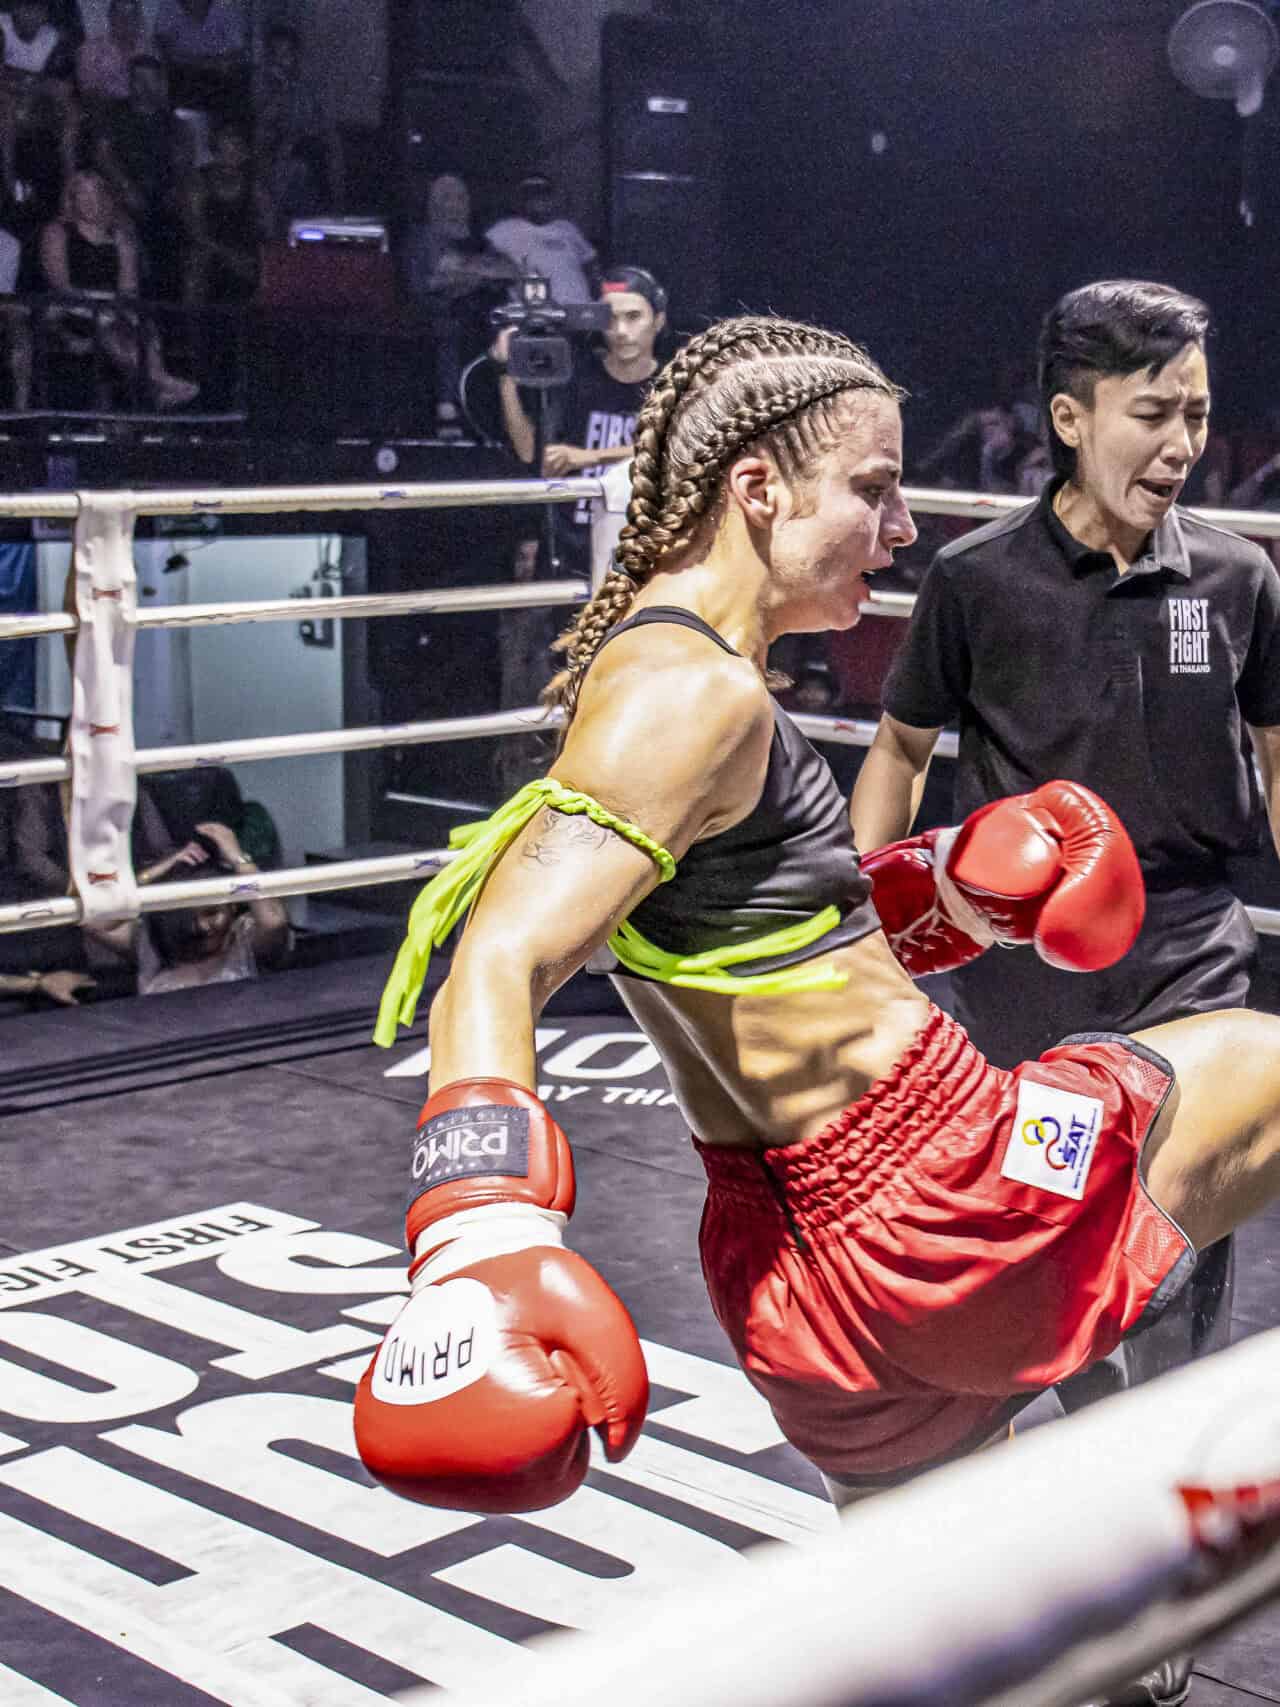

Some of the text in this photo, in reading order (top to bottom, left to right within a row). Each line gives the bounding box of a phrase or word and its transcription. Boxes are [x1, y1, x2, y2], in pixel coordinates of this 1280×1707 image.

[1167, 598, 1209, 631] FIRST
[1169, 631, 1210, 664] FIGHT
[412, 1125, 509, 1179] PRIMO
[1059, 1113, 1088, 1169] SAT
[0, 1215, 273, 1291] FIRST FIG
[385, 1326, 475, 1387] PRIMO
